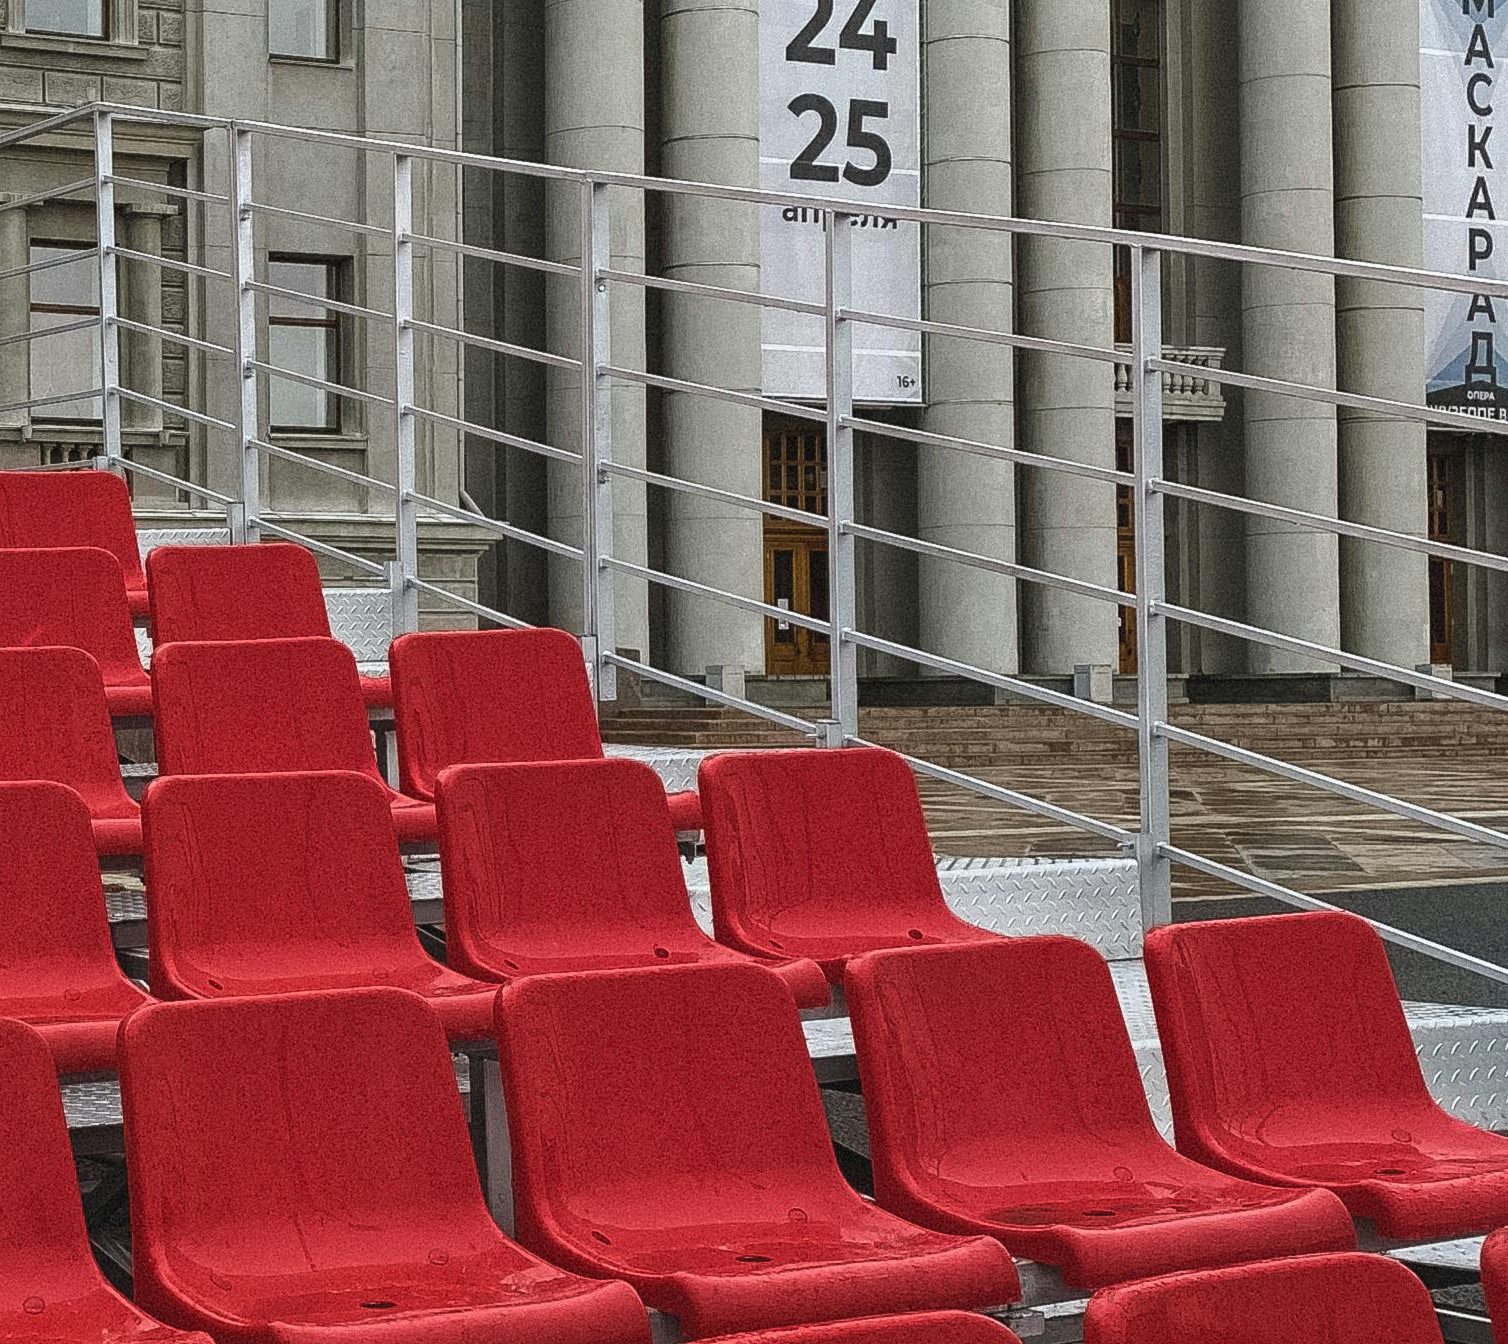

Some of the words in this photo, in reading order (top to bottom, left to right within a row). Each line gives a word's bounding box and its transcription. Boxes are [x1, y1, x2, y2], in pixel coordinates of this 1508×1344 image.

[786, 93, 892, 187] 25
[896, 375, 916, 389] 16+
[1467, 390, 1496, 401] ОПЕРА
